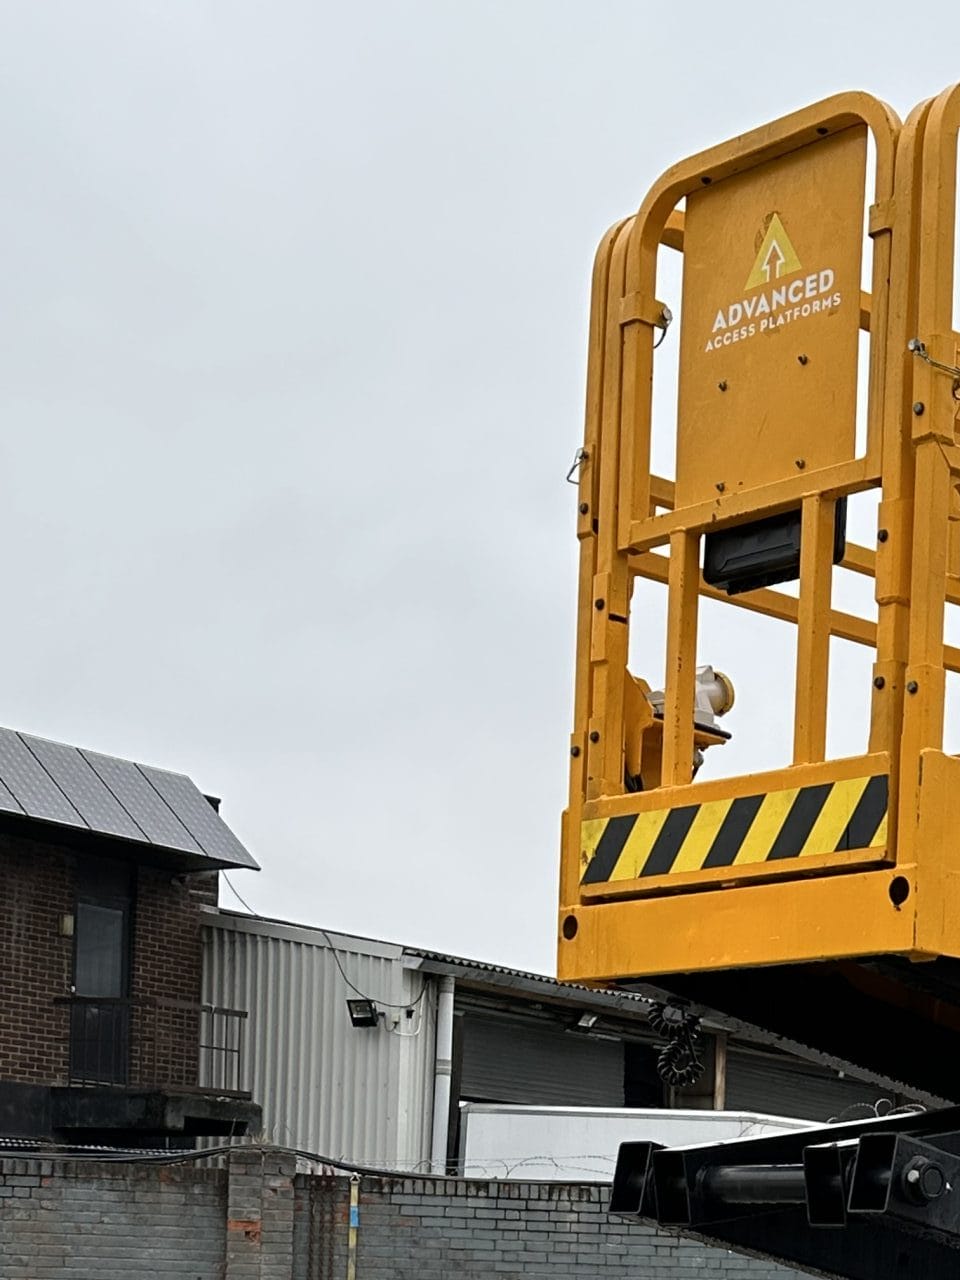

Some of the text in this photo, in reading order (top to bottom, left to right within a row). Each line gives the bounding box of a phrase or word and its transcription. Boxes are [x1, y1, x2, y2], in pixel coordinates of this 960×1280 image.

[705, 293, 841, 352] ACCESS PLATFORMS
[712, 269, 834, 332] ADVANCED
